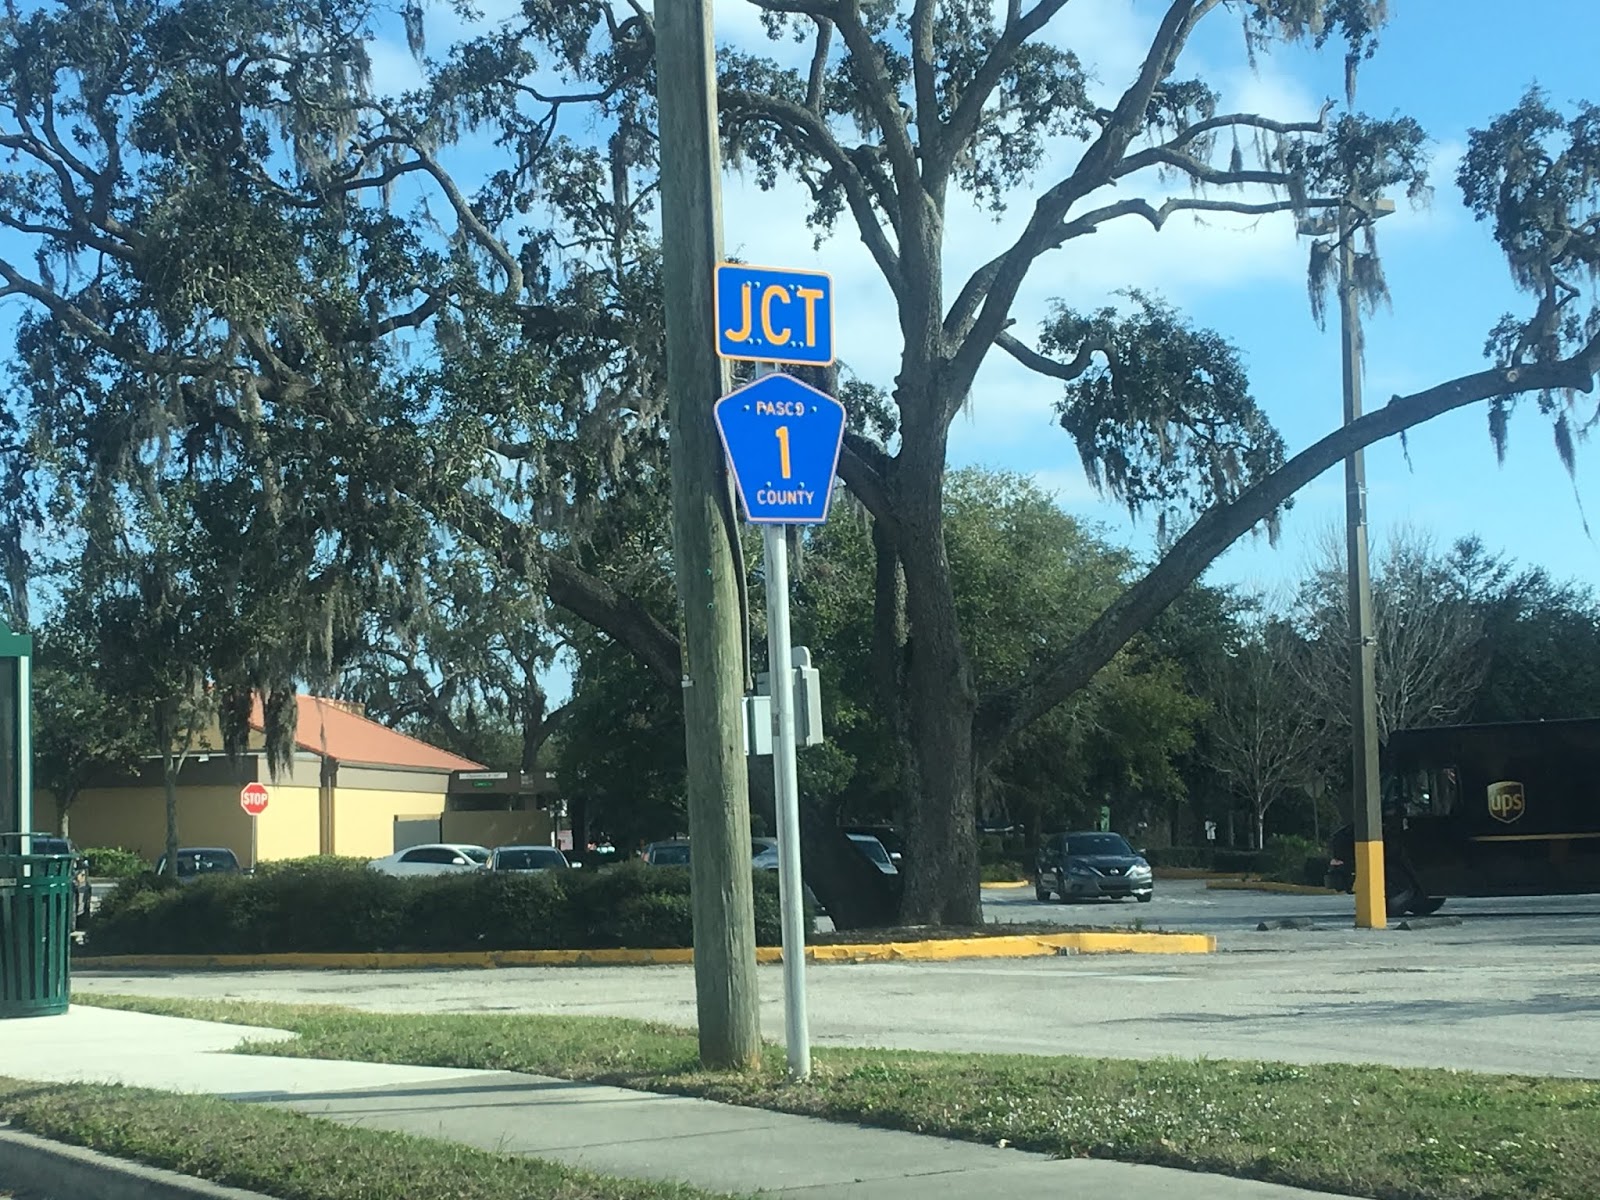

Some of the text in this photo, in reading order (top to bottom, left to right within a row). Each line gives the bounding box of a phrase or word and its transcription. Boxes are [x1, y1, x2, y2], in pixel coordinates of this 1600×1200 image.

[725, 283, 824, 347] JCT
[756, 401, 805, 416] PASCO
[775, 426, 791, 479] 1
[756, 489, 814, 506] COUNTY
[243, 792, 268, 806] STOP
[1491, 794, 1522, 817] ups
